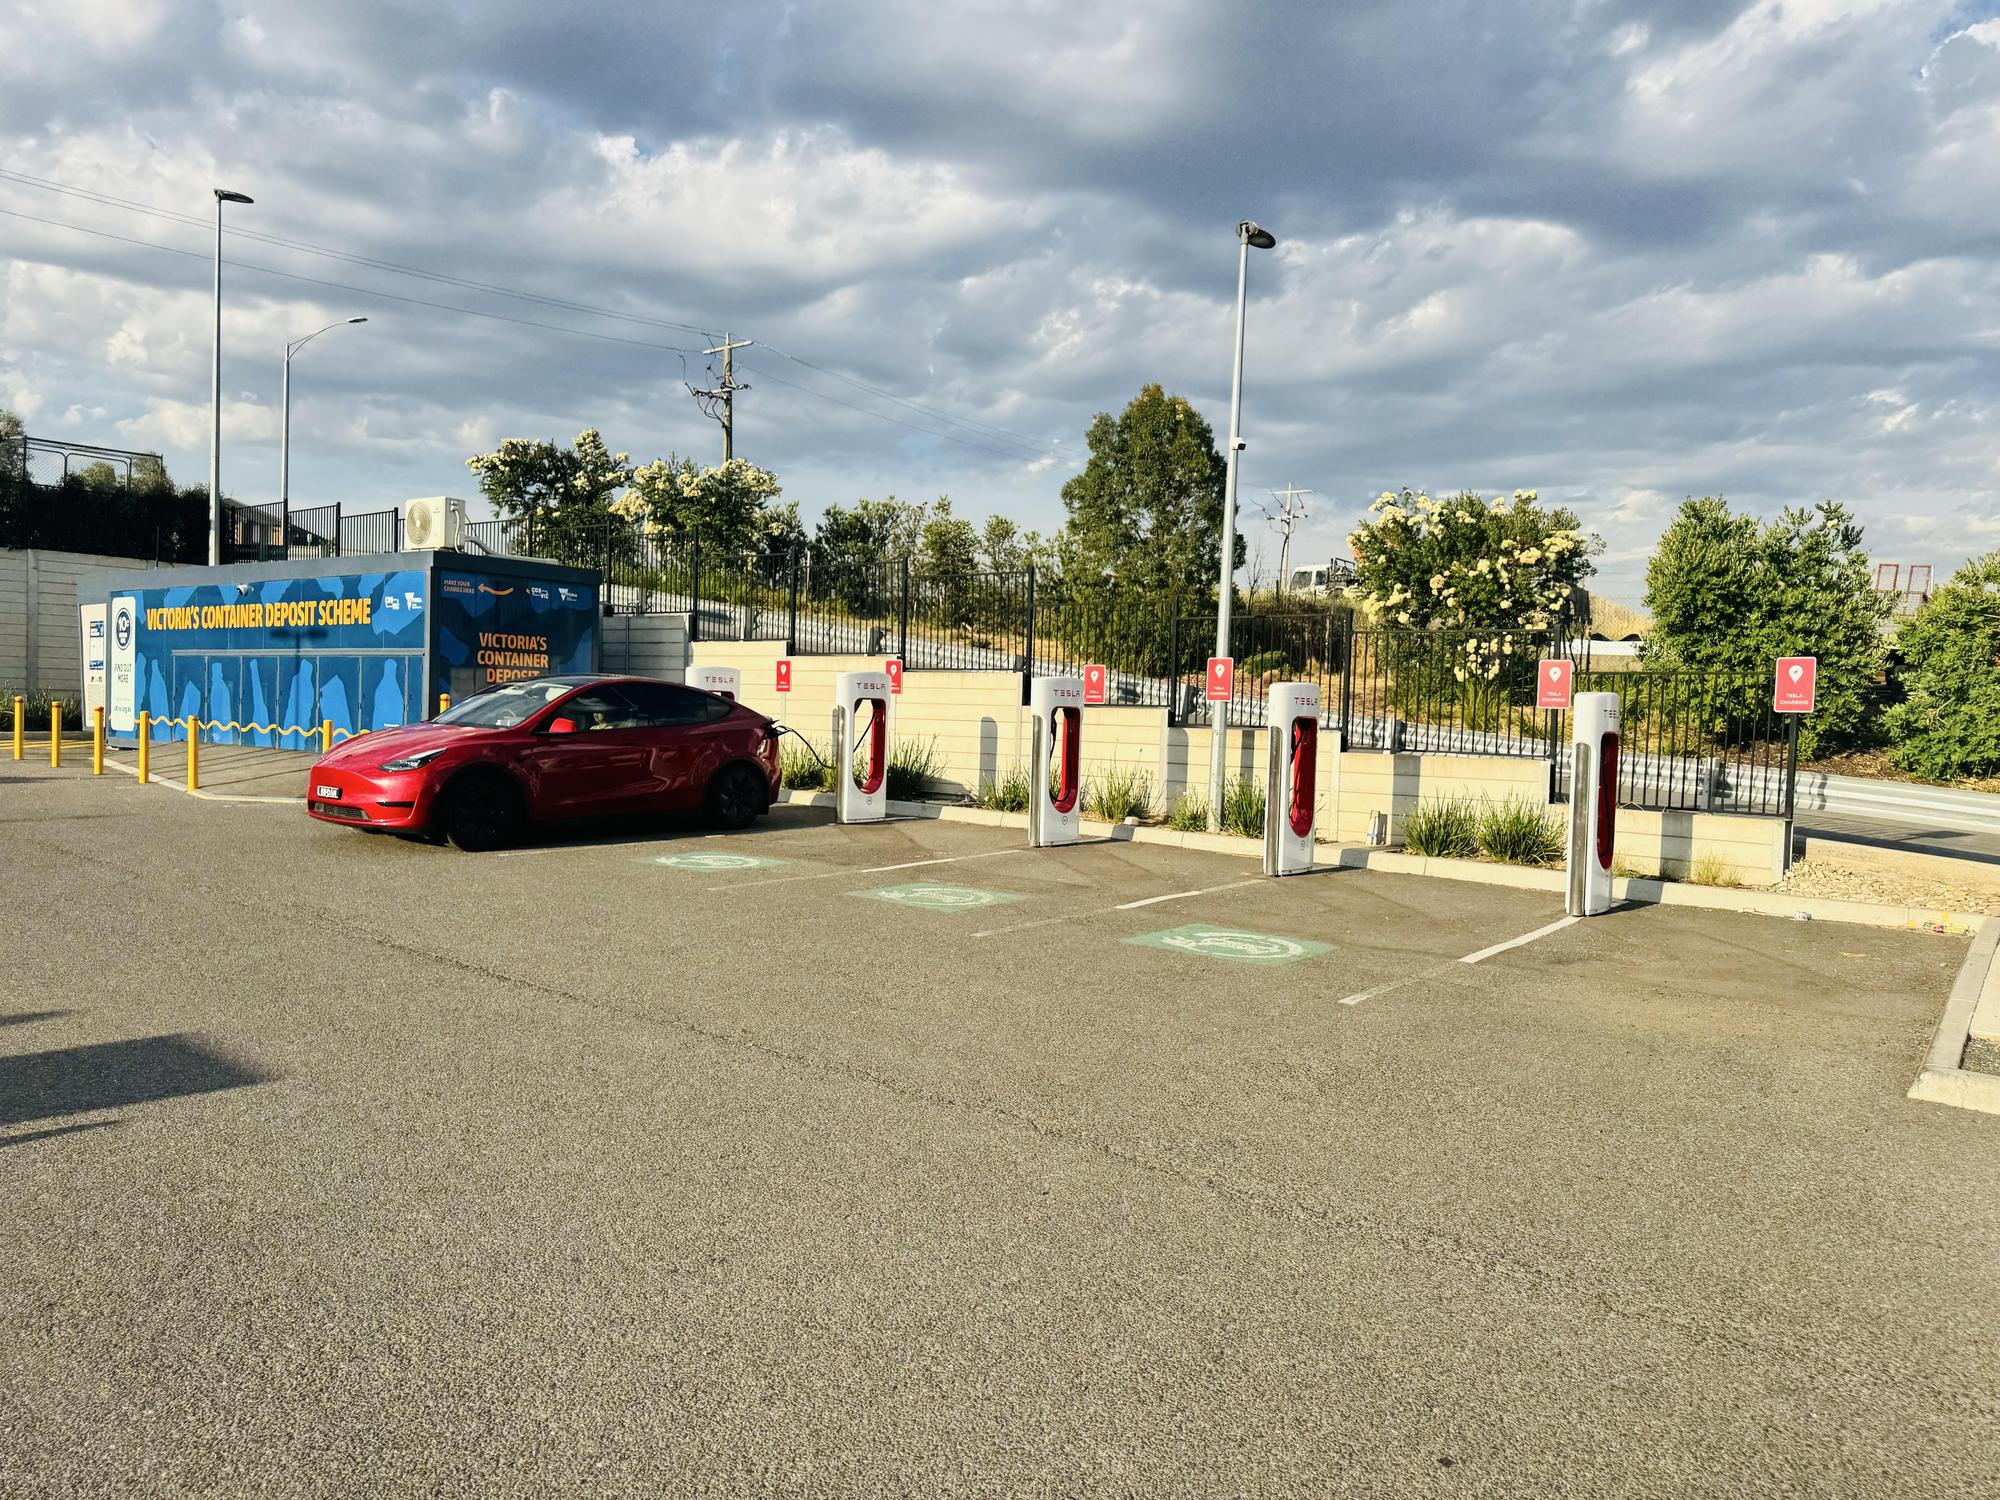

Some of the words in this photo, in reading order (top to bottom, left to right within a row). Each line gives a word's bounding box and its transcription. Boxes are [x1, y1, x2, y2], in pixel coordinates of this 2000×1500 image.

[147, 605, 200, 631] VICTORIA'S
[201, 603, 263, 630] CONTAINER
[265, 600, 317, 628] DEPOSIT
[318, 597, 371, 626] SCHEME
[479, 632, 548, 651] VICTORIA'S
[477, 650, 549, 669] CONTAINER
[704, 676, 735, 684] TESLA
[856, 682, 886, 691] TESLA
[1053, 689, 1081, 698] TESLA
[1603, 709, 1619, 719] TES
